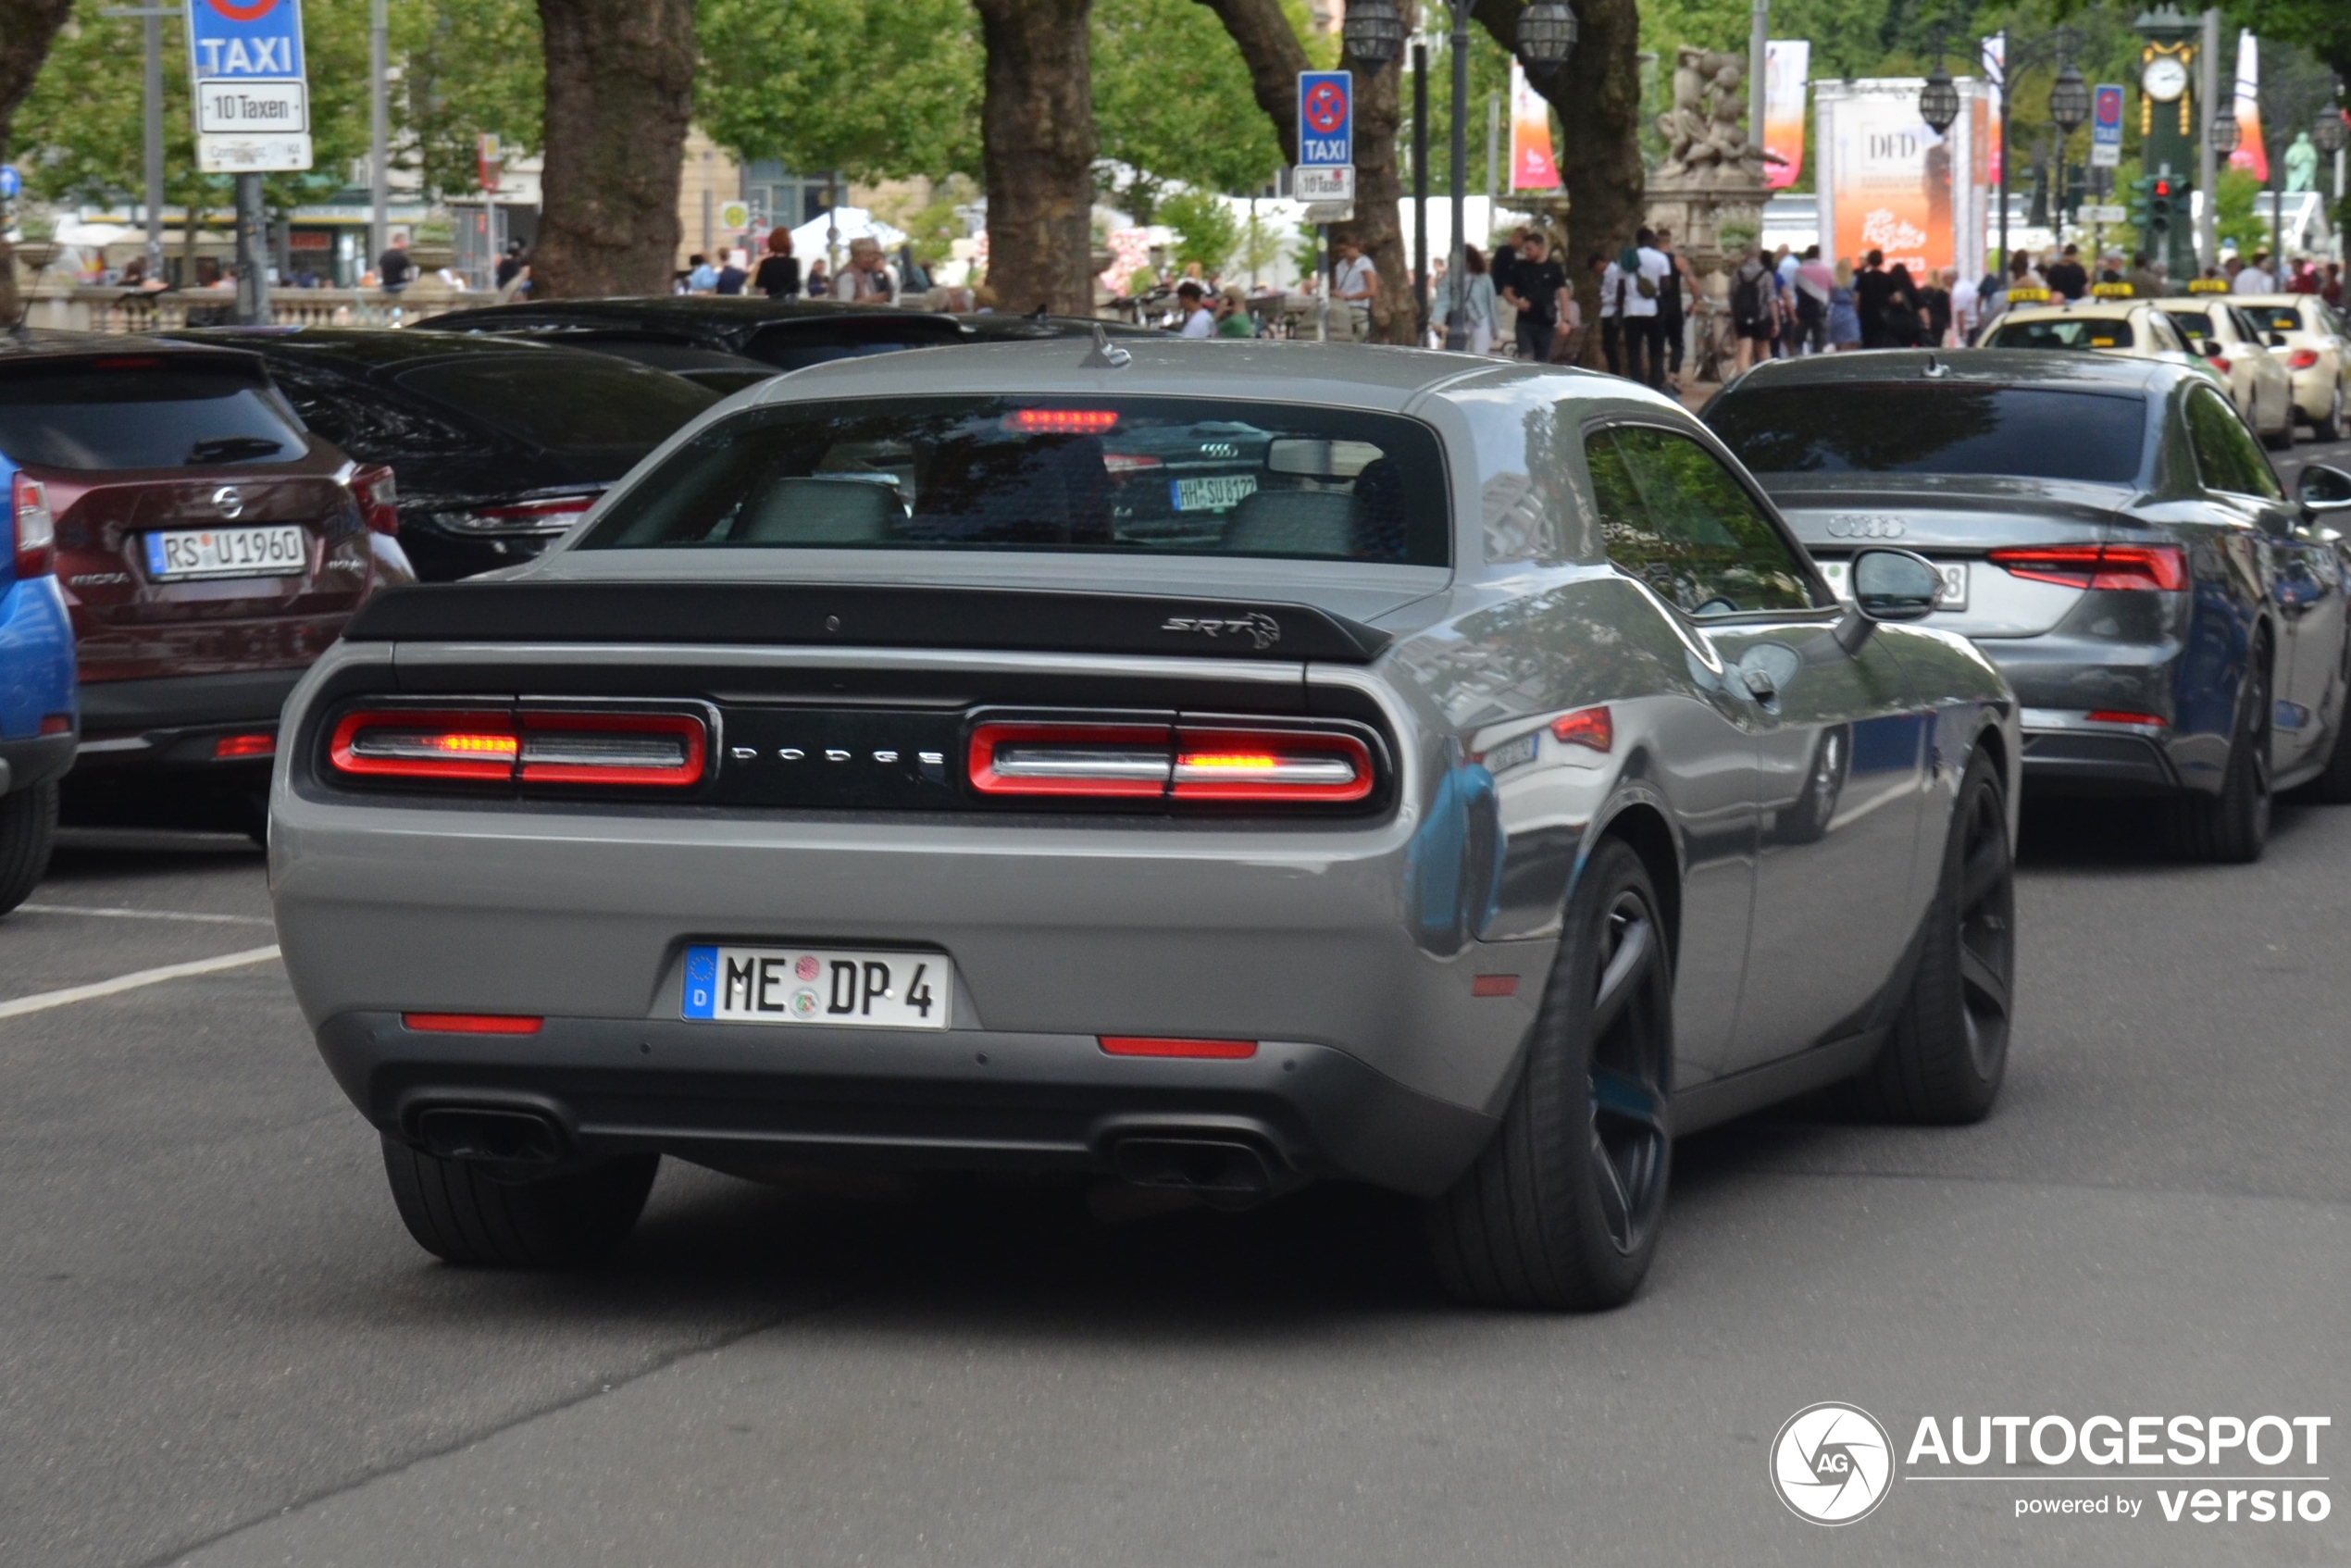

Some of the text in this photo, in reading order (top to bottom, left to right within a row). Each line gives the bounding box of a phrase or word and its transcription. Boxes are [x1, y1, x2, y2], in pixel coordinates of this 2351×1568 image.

[197, 37, 292, 74] TAXI
[213, 94, 289, 119] 10 Taxen
[1304, 140, 1346, 161] TAXI
[1870, 134, 1916, 159] DFD
[1303, 176, 1316, 193] 10
[1180, 483, 1199, 506] HH
[1206, 479, 1224, 504] SU
[165, 537, 199, 568] RS
[1161, 617, 1254, 637] SRT
[730, 747, 944, 765] DODGE
[693, 989, 707, 1006] D
[725, 956, 933, 1017] ME DP 4
